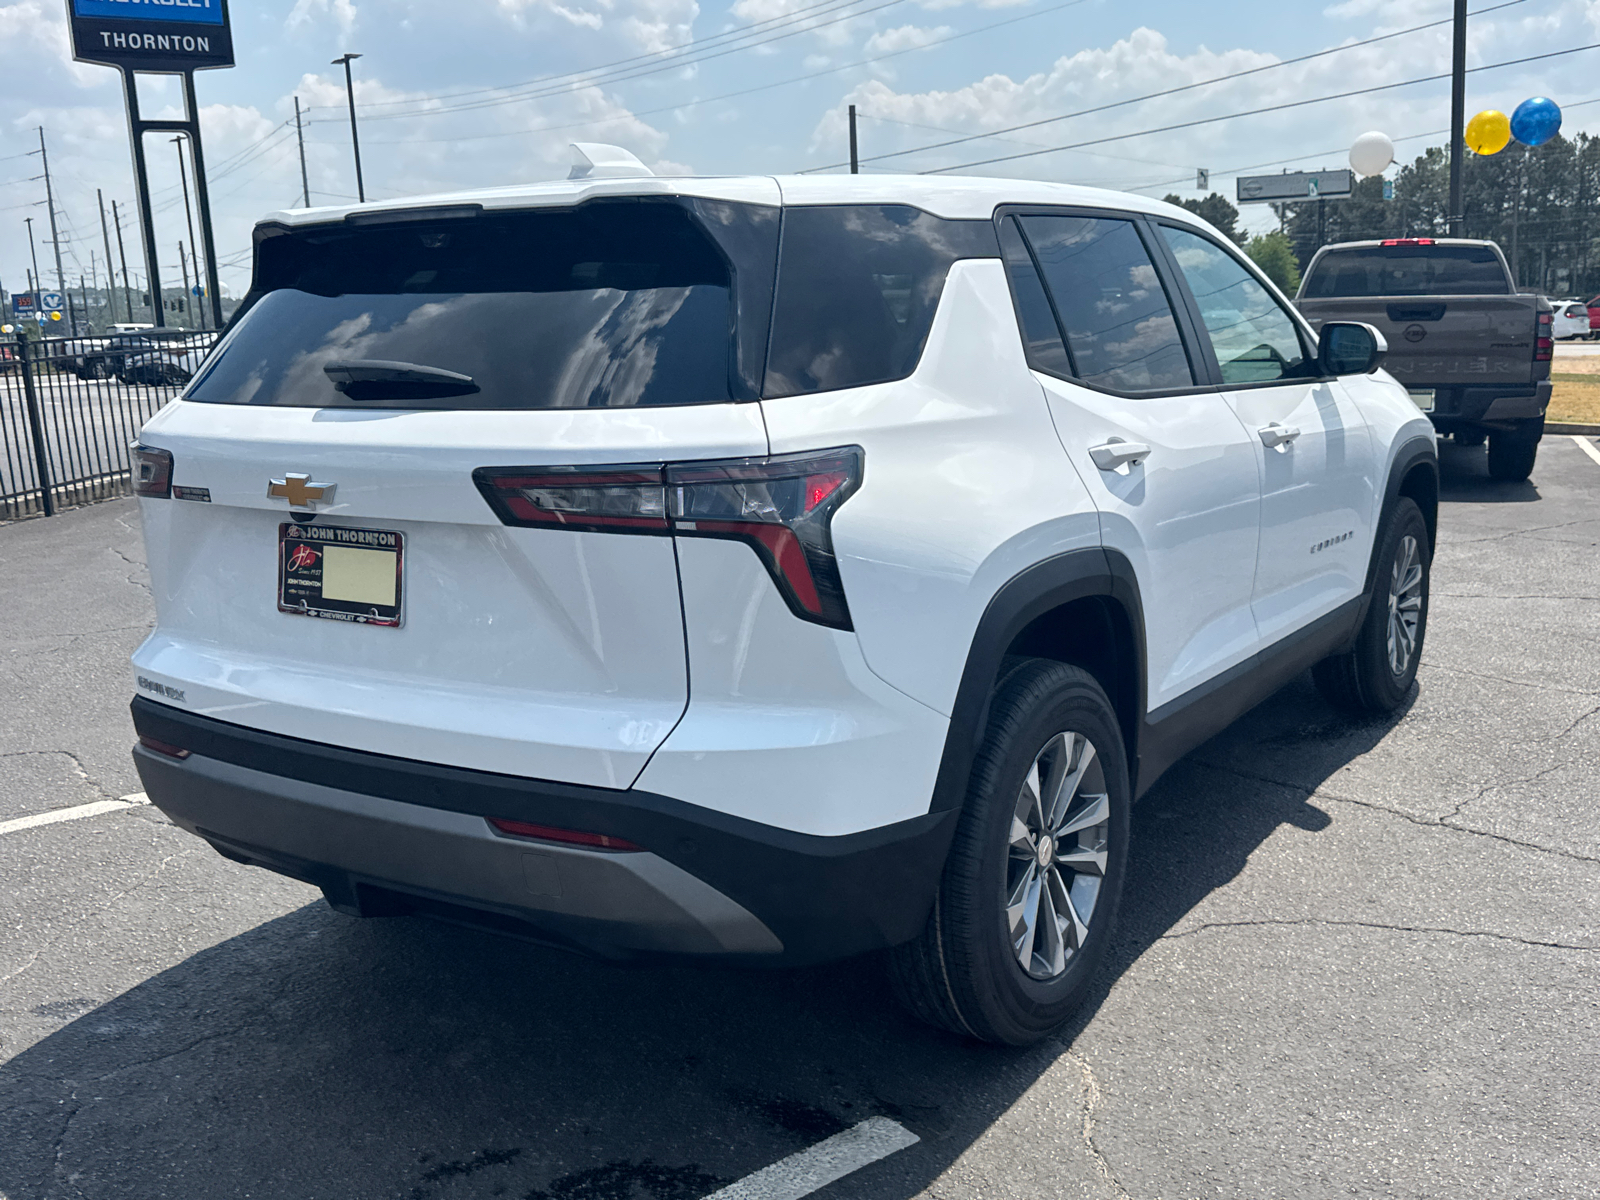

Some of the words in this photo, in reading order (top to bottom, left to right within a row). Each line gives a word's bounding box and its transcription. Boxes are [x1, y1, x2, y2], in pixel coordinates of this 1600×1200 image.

[100, 31, 210, 52] THORNTON
[306, 527, 334, 540] JOHN
[336, 530, 396, 545] THORNTON
[320, 611, 355, 621] CHEVROLET
